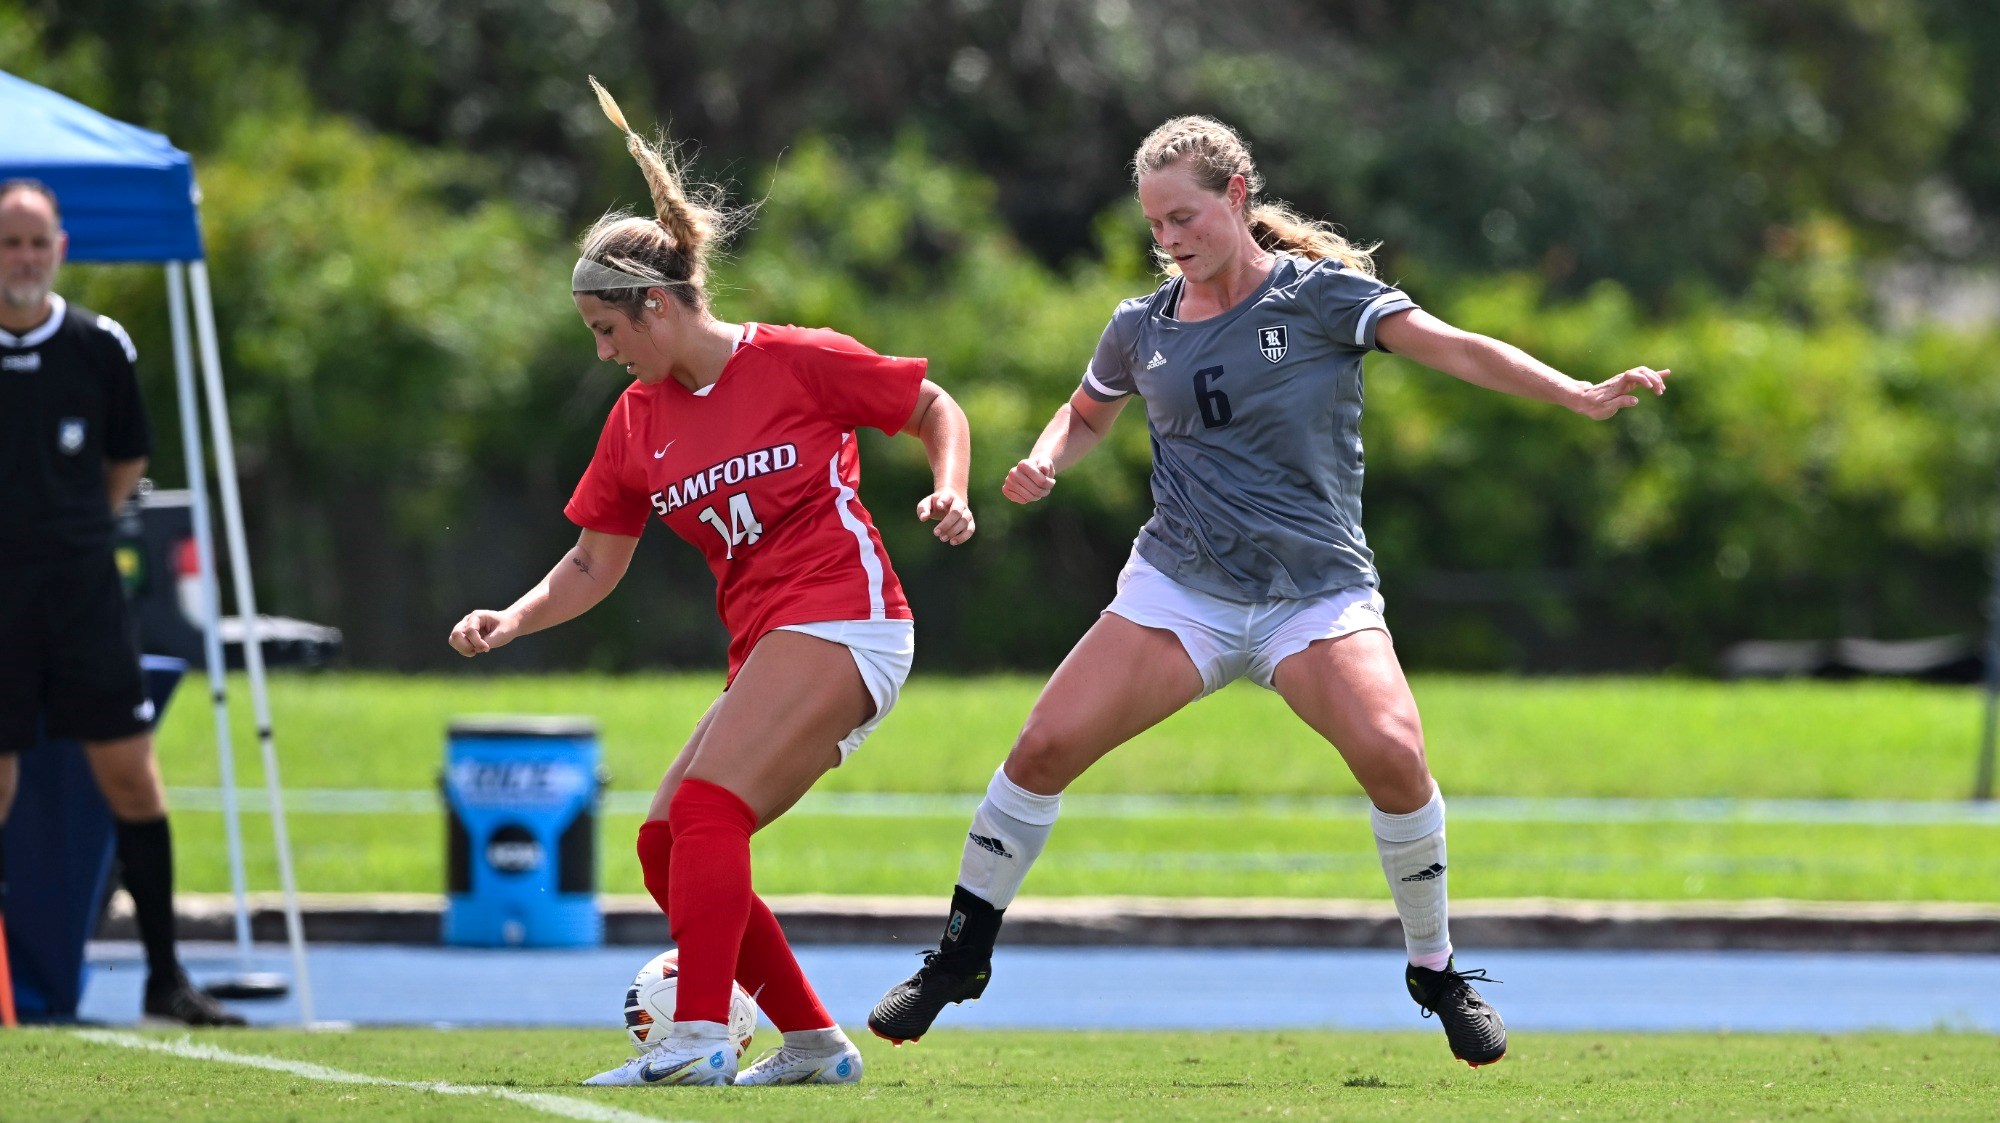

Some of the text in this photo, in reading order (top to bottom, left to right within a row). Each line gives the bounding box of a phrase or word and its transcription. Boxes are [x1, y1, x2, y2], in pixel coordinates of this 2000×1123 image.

[1265, 330, 1281, 346] R
[1193, 365, 1233, 429] 6
[650, 442, 799, 516] SAMFORD
[698, 491, 763, 560] 14
[969, 832, 1013, 858] adidas
